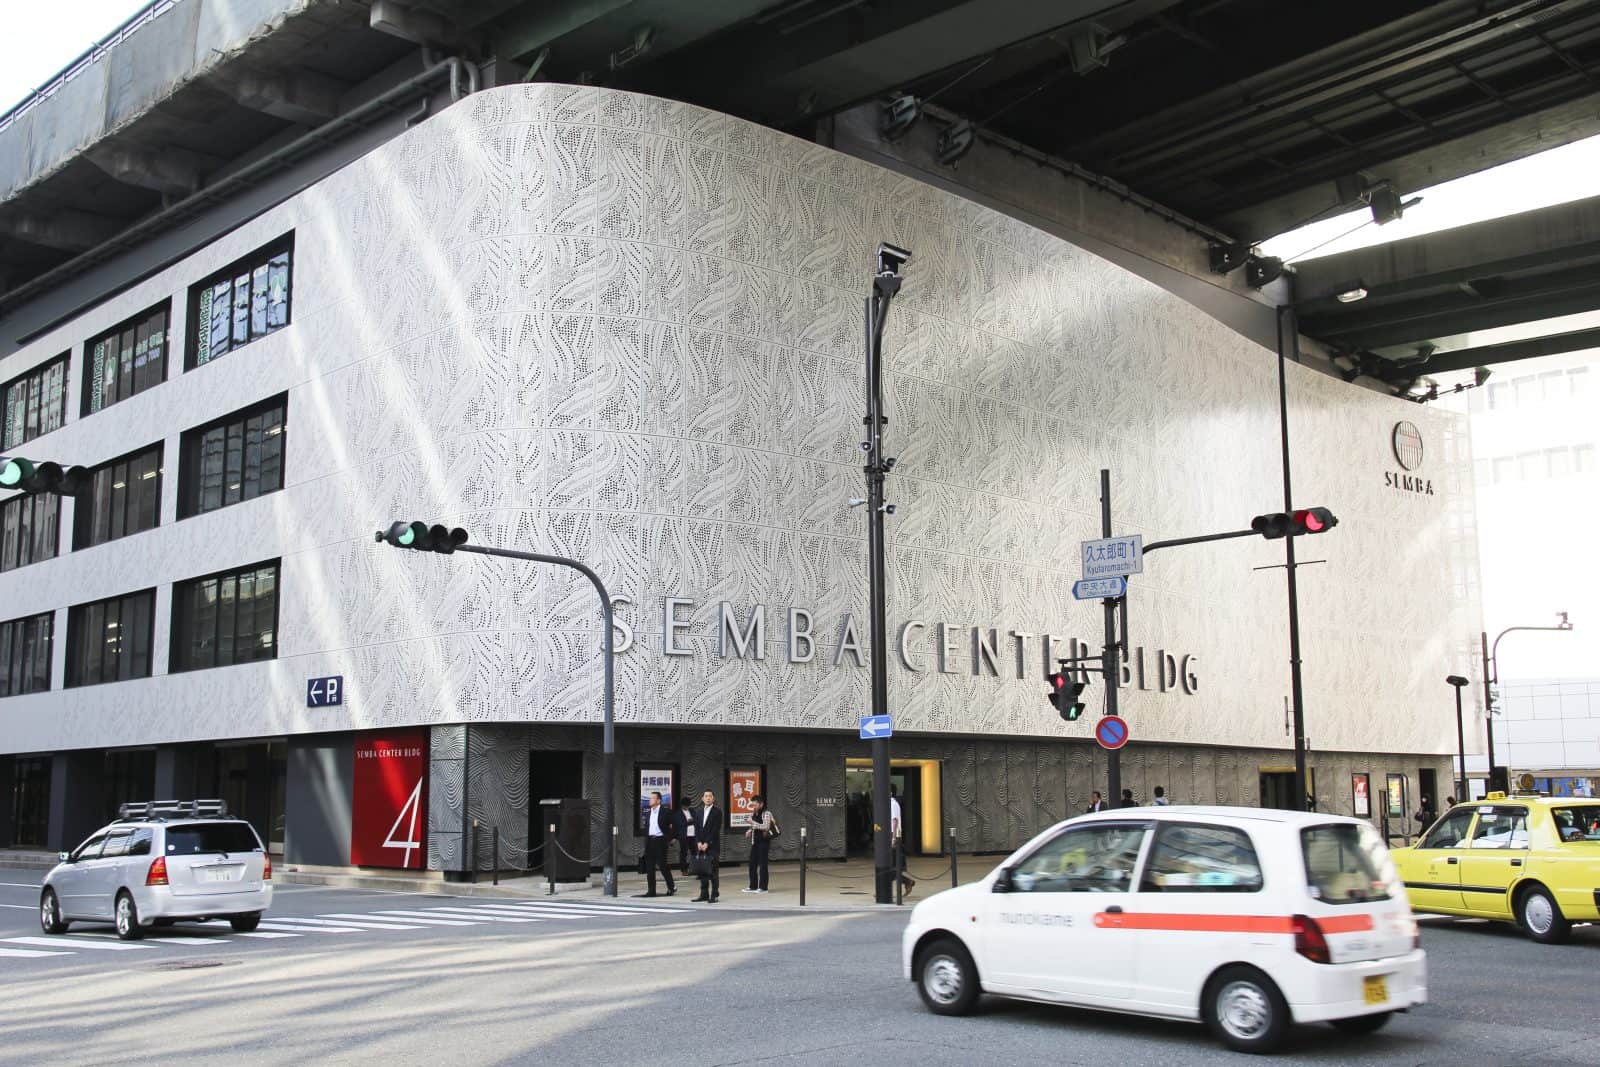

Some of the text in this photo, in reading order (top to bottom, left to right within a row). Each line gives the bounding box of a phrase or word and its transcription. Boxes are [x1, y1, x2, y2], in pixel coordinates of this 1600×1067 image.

[600, 594, 1199, 695] SEMBA CENTER BLDG
[326, 678, 338, 704] P
[357, 748, 421, 759] SEMBA CENTER BLDG
[381, 776, 423, 868] 4
